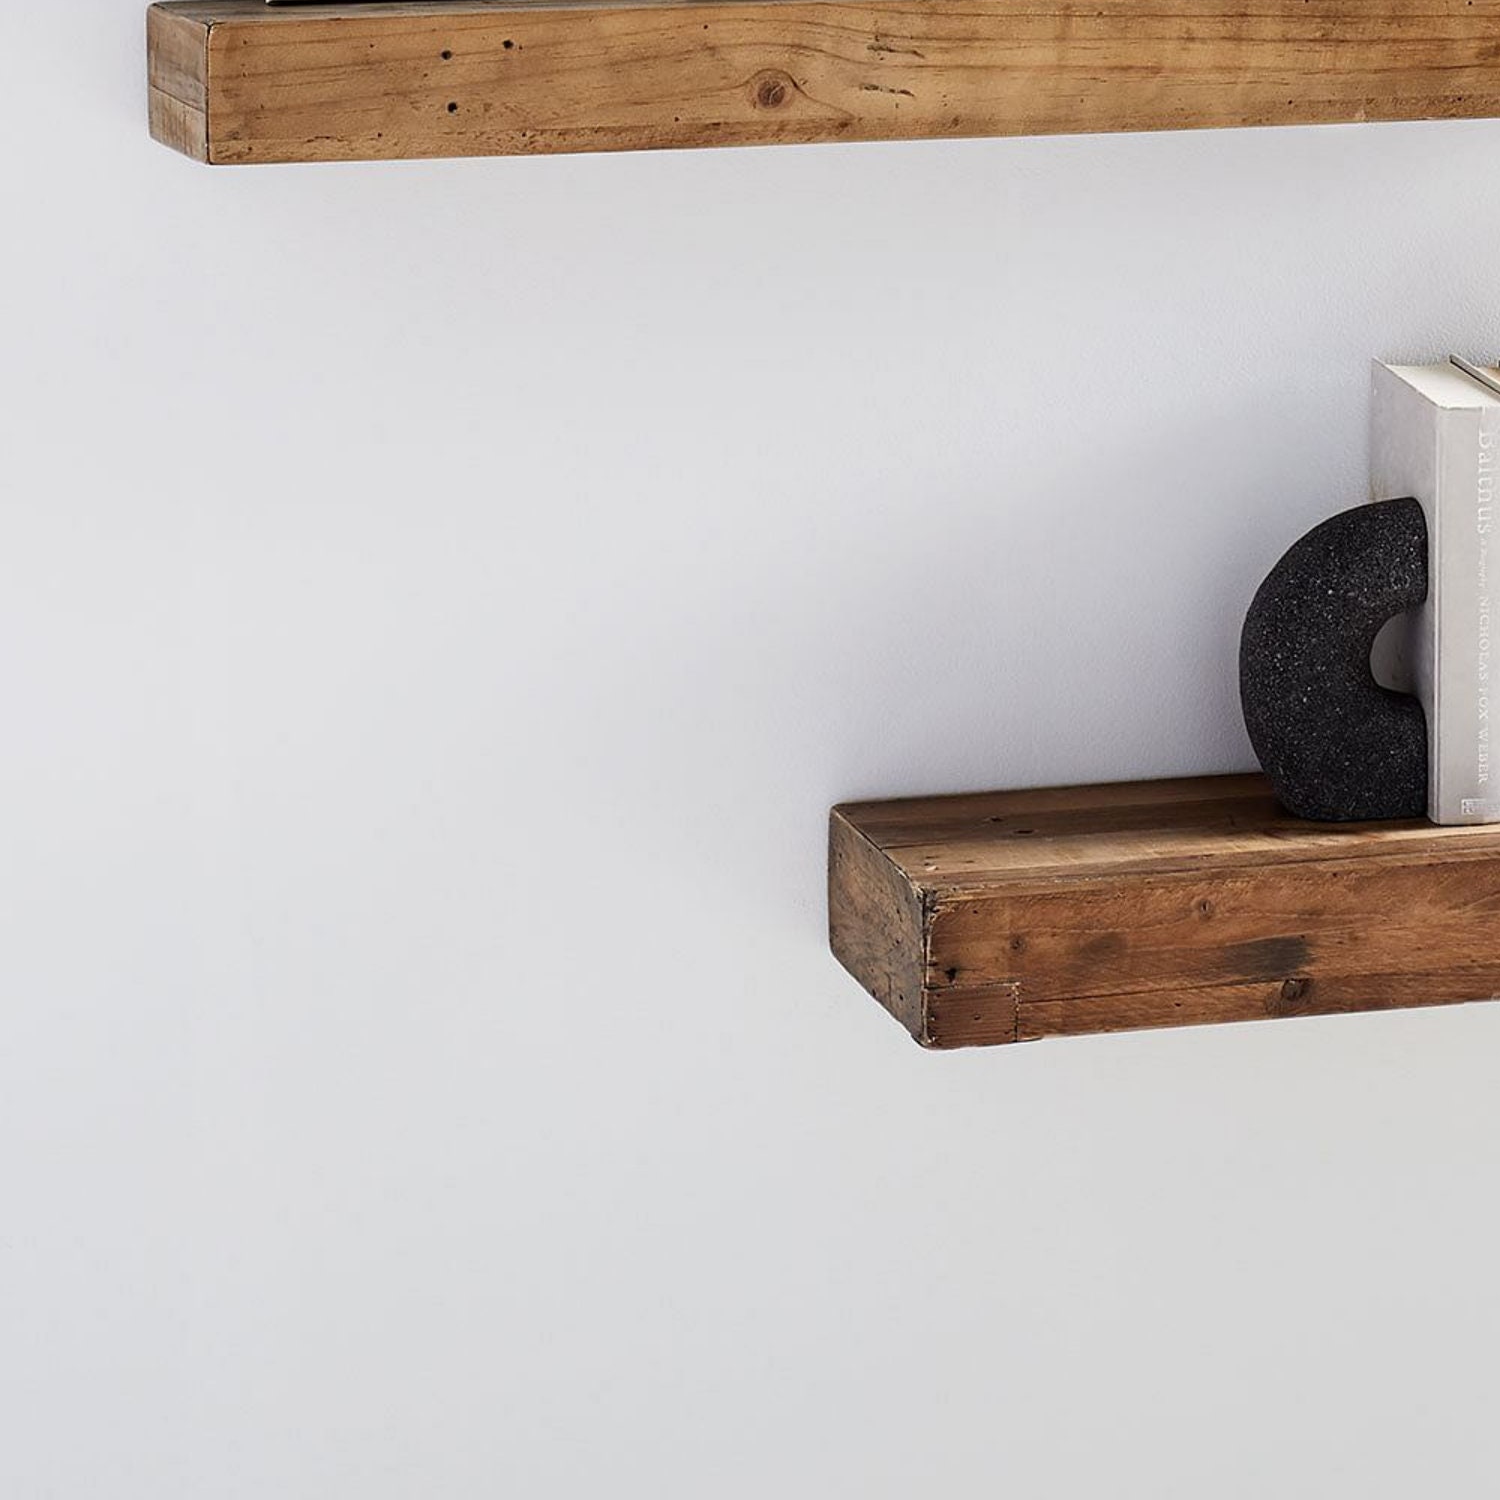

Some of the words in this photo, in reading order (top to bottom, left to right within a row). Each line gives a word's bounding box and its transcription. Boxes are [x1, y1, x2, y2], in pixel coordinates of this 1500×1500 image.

[1477, 427, 1497, 535] Balthus
[1478, 596, 1490, 681] NICHOLAS
[1478, 687, 1490, 720] FOX
[1478, 727, 1490, 784] WEBER
